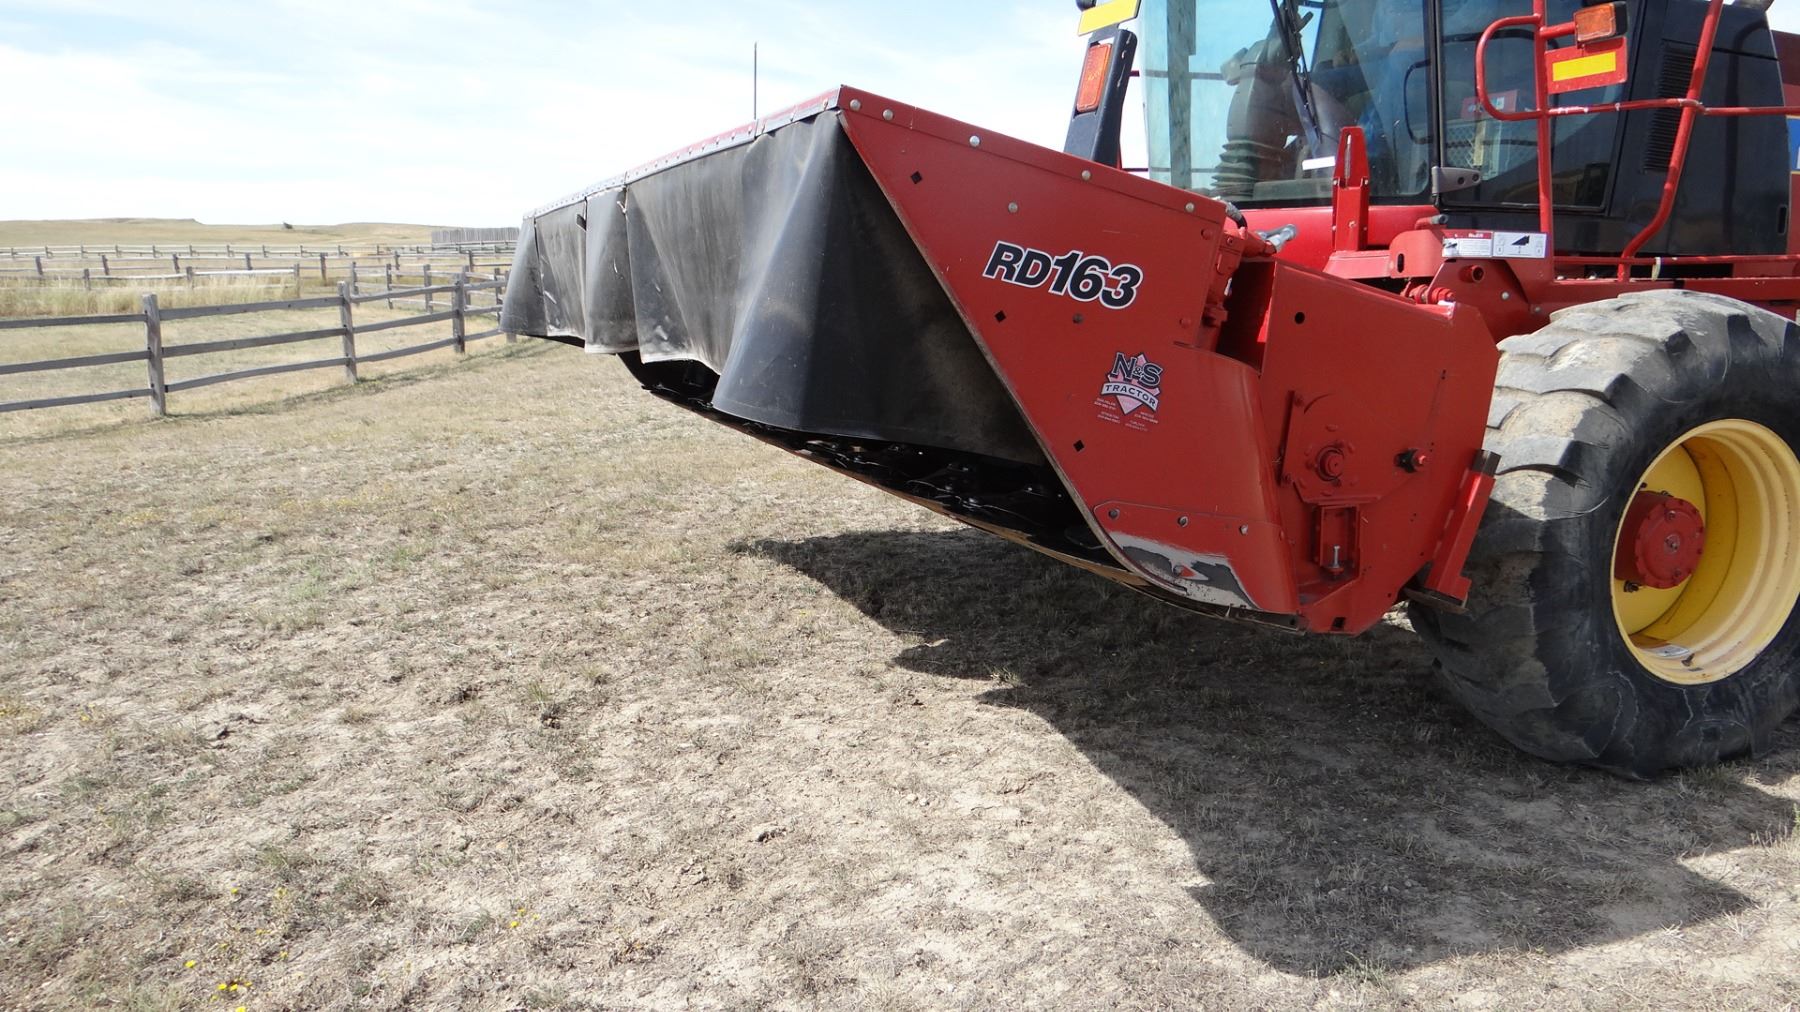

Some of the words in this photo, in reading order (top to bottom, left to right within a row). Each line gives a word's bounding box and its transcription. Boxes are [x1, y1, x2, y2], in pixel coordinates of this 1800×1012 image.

[983, 240, 1143, 309] RD163
[1110, 352, 1163, 386] N&S
[1105, 384, 1157, 407] TRACTOR
